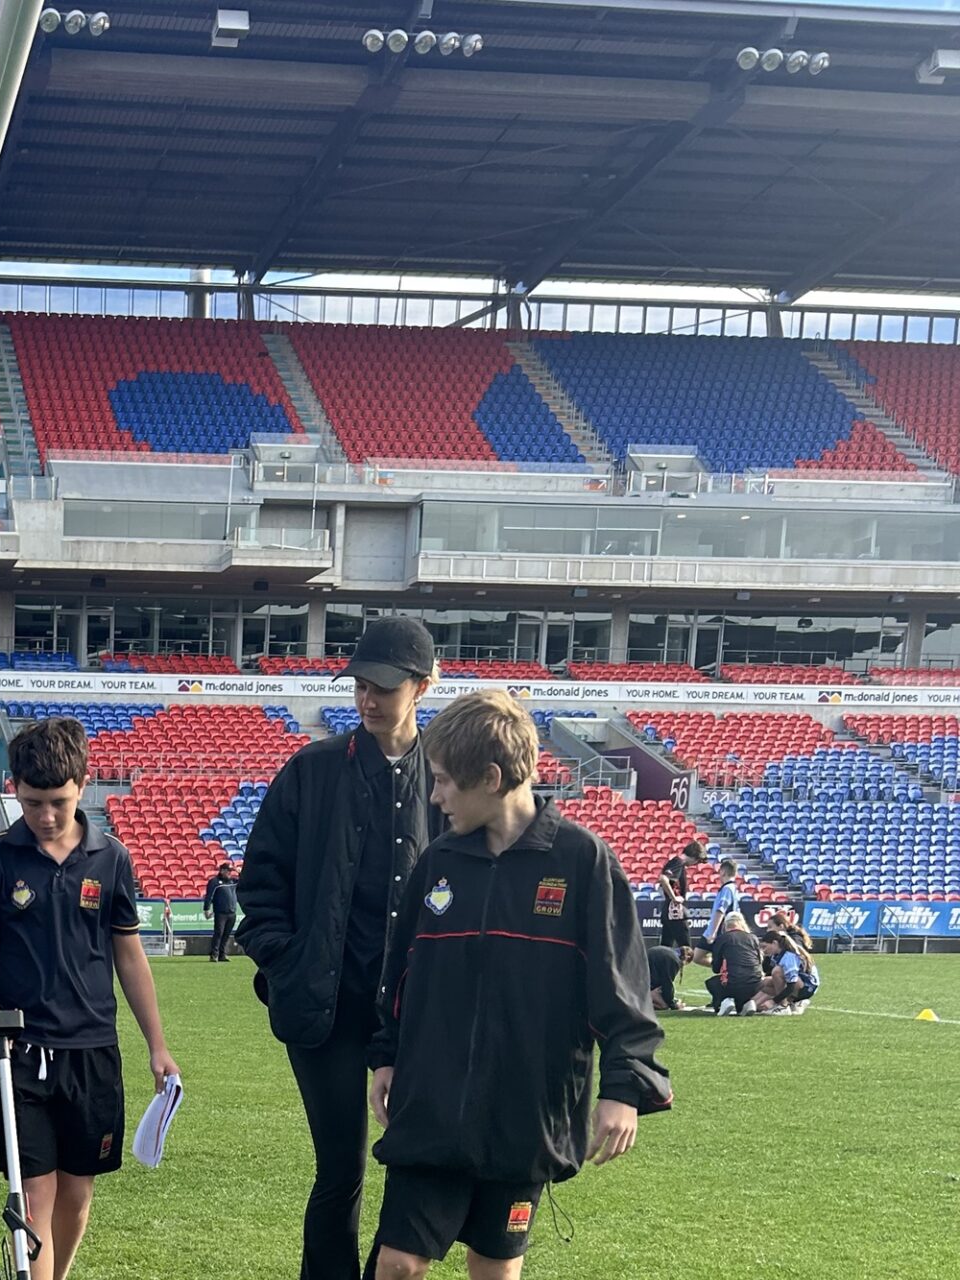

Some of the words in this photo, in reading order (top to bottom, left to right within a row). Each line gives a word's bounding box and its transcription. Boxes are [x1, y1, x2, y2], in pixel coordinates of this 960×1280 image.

[30, 679, 56, 688] YOUR
[57, 679, 93, 689] DREAM.
[101, 680, 128, 690] YOUR
[128, 680, 156, 690] TEAM.
[205, 681, 253, 692] mcdonald
[255, 681, 284, 693] jones
[300, 682, 327, 692] YOUR
[327, 683, 354, 693] HOME
[432, 686, 457, 695] YOUR
[532, 686, 580, 697] mcdonald
[581, 687, 609, 699] jones
[626, 689, 651, 698] YOUR
[686, 690, 711, 699] YOUR
[711, 690, 746, 700] DREAM.
[753, 691, 778, 701] YOUR
[779, 692, 805, 701] TEAM.
[843, 692, 890, 703] mcdonald
[890, 692, 918, 704] jones
[927, 693, 952, 703] YOUR
[670, 777, 689, 809] 56
[702, 791, 717, 803] 56
[809, 906, 871, 929] Thrifty
[882, 906, 941, 929] Thrifty
